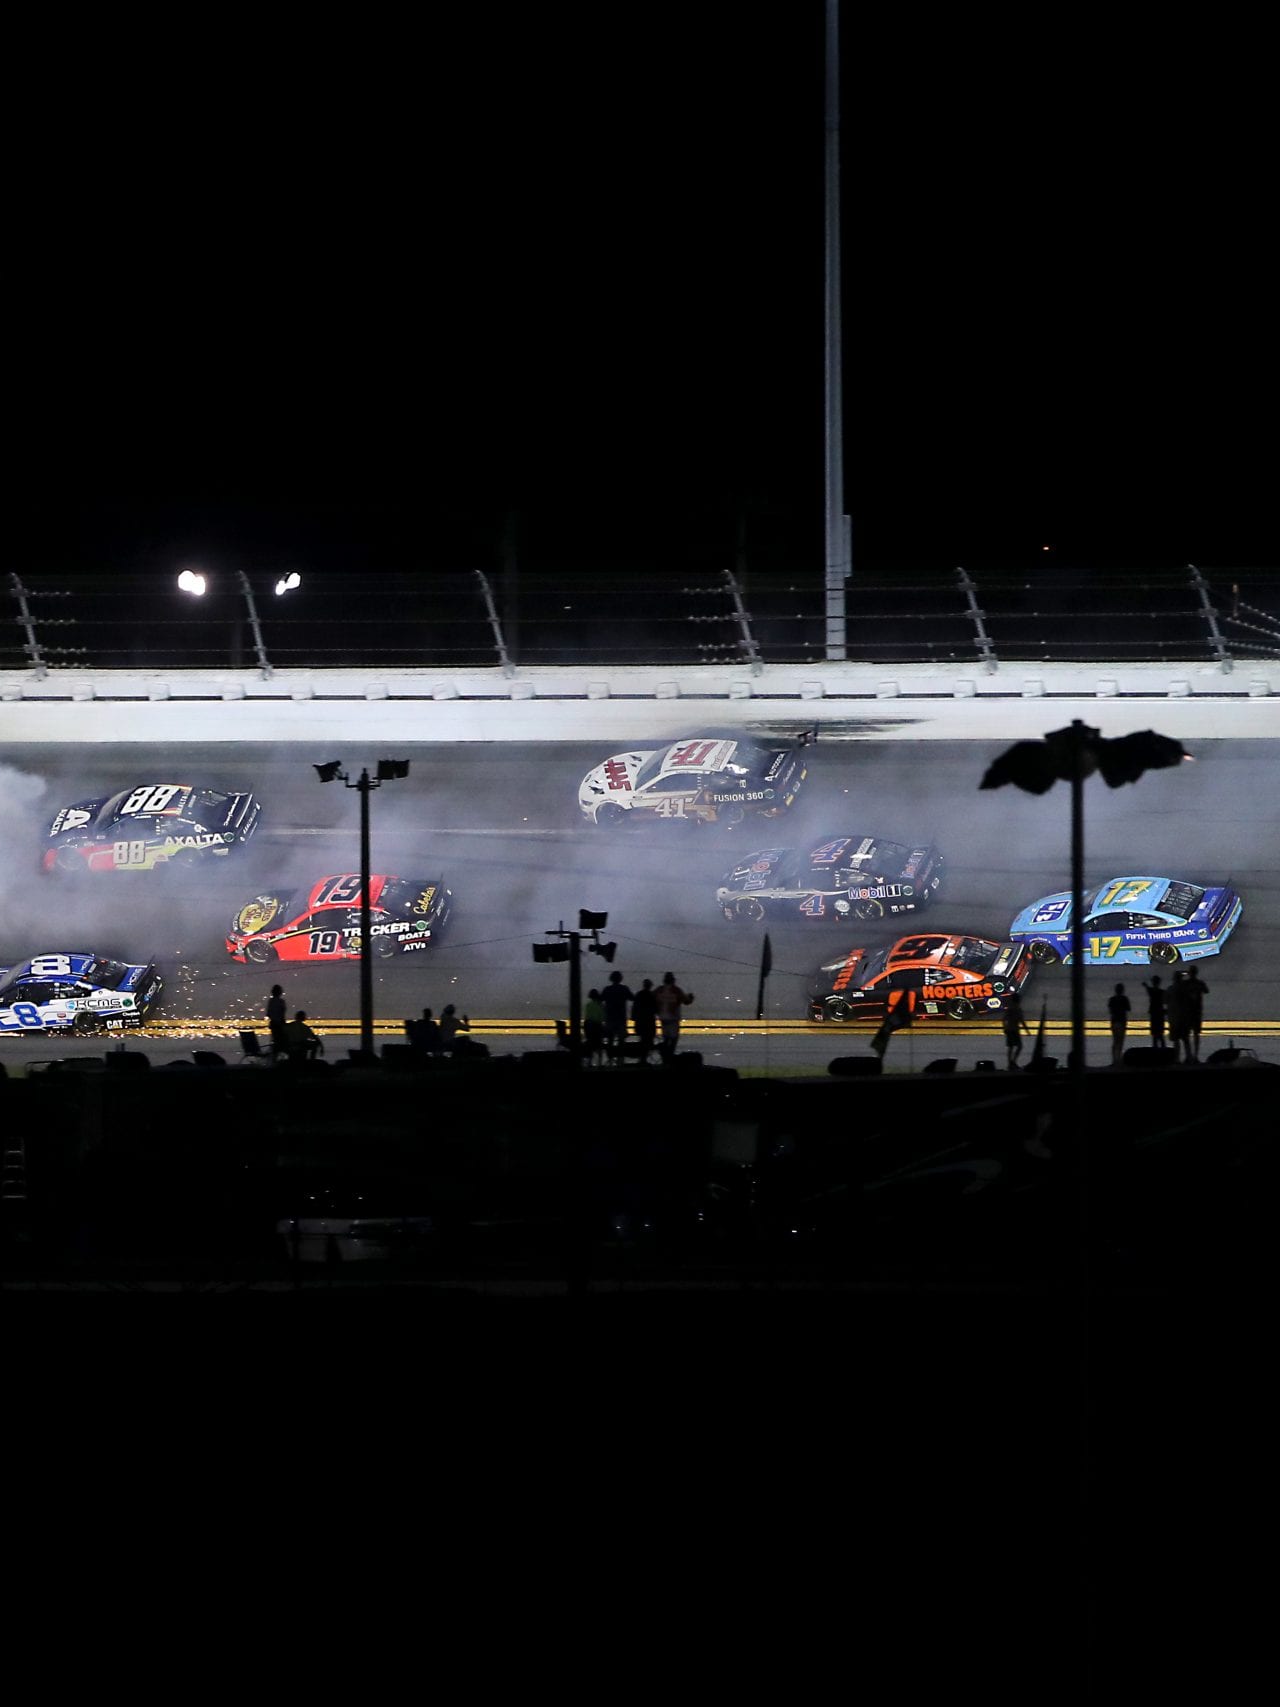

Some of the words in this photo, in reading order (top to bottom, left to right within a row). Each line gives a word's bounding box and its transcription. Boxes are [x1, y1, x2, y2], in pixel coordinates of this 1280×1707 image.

[670, 741, 718, 766] 41
[603, 758, 633, 792] HAAS
[120, 786, 181, 815] 88
[651, 797, 689, 818] 41
[713, 794, 745, 803] FUSION
[747, 791, 764, 801] 360
[163, 832, 225, 848] AXALTA
[811, 838, 852, 864] 4
[113, 841, 146, 865] 88
[313, 875, 373, 907] 19
[413, 886, 437, 915] Cabela's
[848, 886, 886, 900] Mobil
[887, 884, 902, 898] 1
[1098, 880, 1154, 908] 17
[800, 894, 825, 917] 4
[342, 922, 411, 938] TRCKER
[397, 930, 431, 942] BOATS
[1126, 931, 1147, 941] FIFTH
[1148, 930, 1173, 940] THIRD
[1173, 928, 1196, 937] BANK
[309, 931, 340, 955] 19
[403, 942, 426, 952] ATVs
[1089, 935, 1123, 960] 17
[31, 955, 71, 976] 8
[922, 982, 994, 1000] HOOTERS
[75, 997, 122, 1008] KCMG
[10, 1002, 45, 1028] 8
[106, 1019, 124, 1030] CAT
